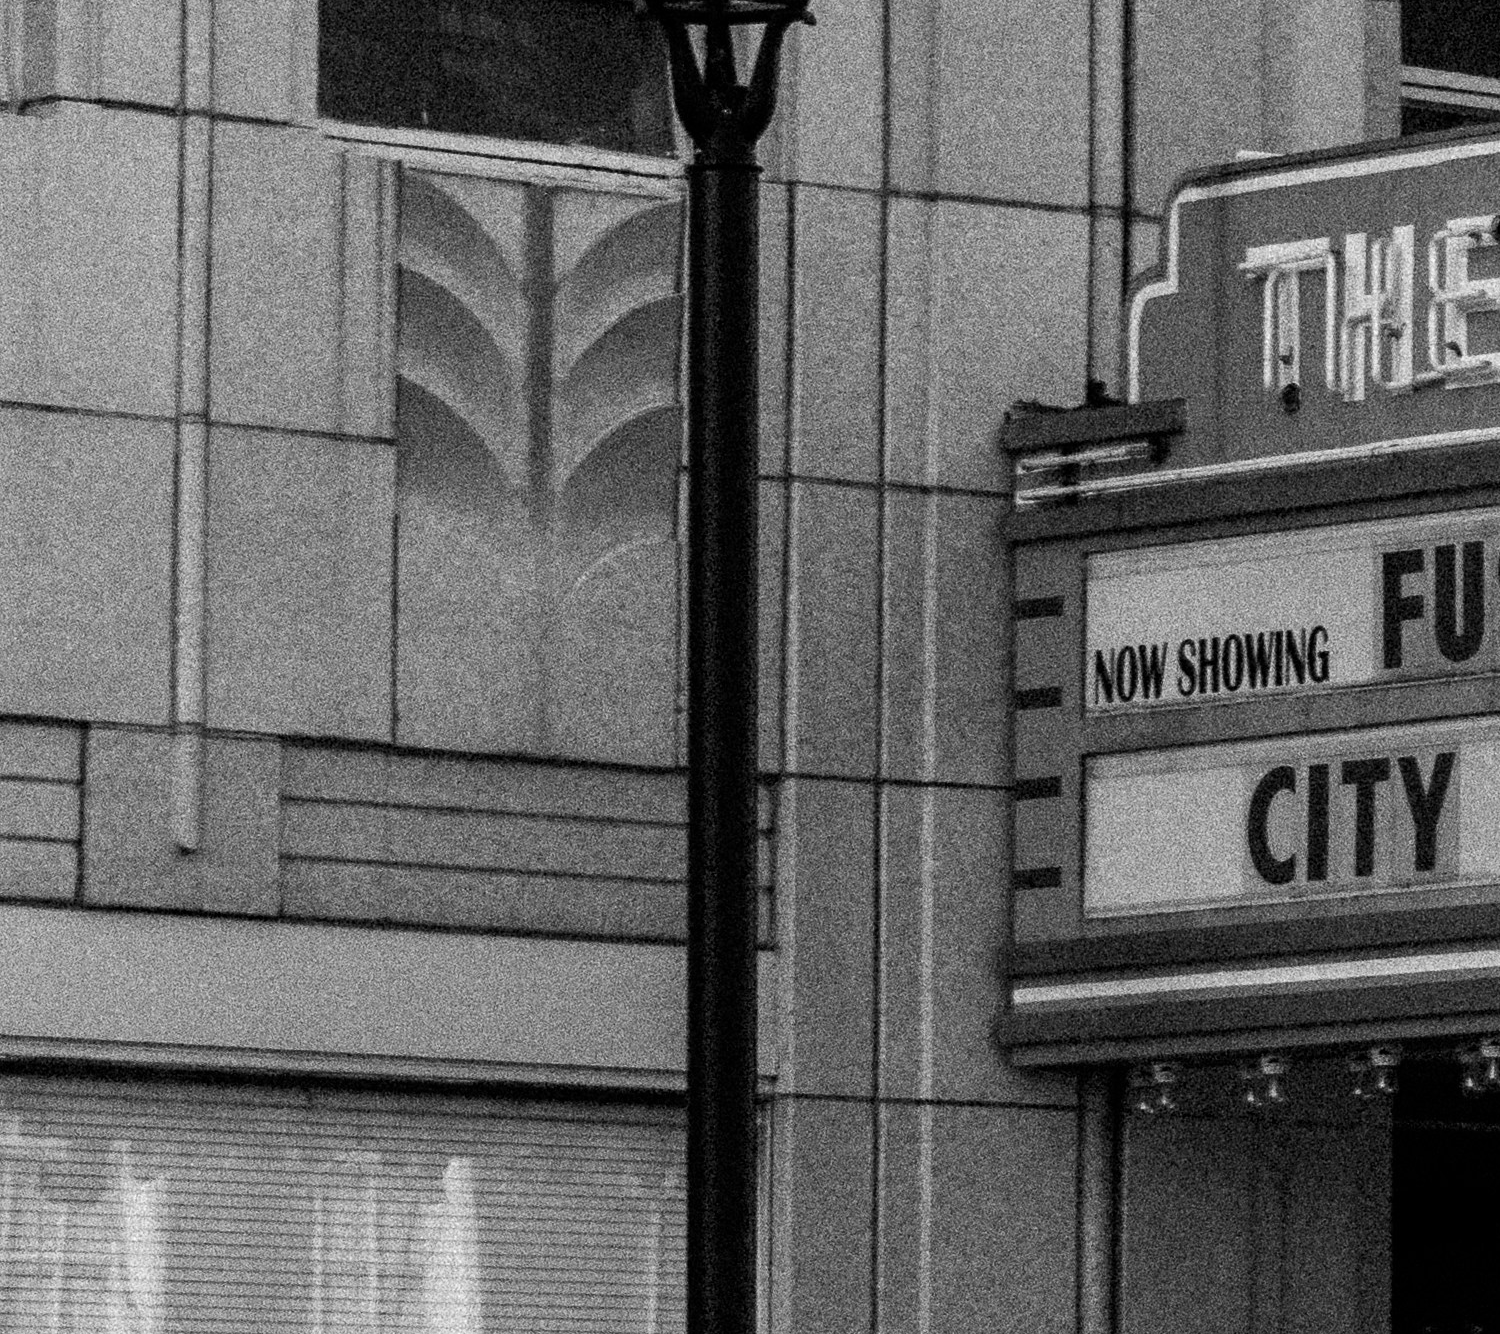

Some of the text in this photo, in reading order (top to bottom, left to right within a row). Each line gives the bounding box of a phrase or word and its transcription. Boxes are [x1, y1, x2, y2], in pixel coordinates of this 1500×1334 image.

[1095, 643, 1168, 704] NOW
[1177, 625, 1330, 698] SHOWING
[1247, 752, 1456, 885] CITY
